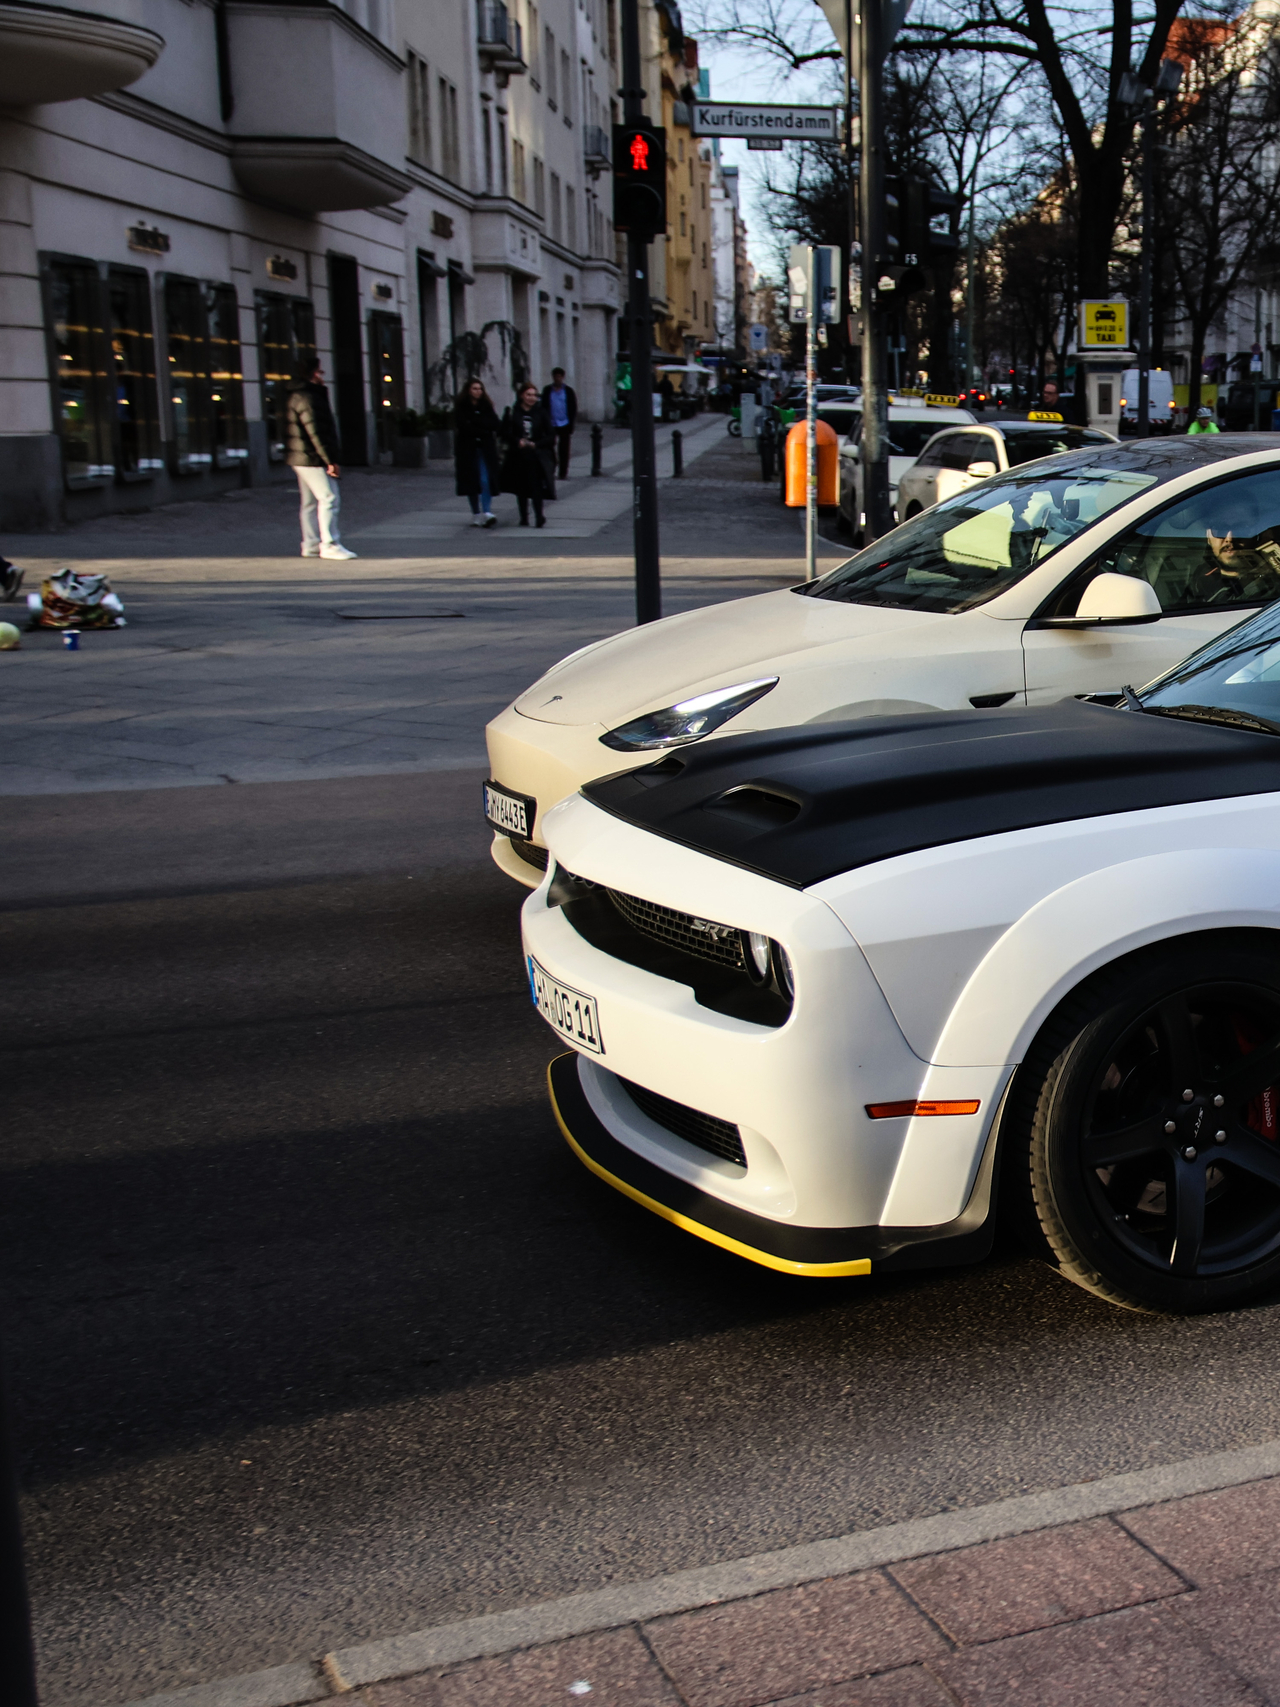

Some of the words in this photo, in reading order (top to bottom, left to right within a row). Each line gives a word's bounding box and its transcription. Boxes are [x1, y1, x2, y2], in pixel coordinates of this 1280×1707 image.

[699, 109, 831, 129] Kurfürstendamm
[690, 918, 736, 942] SRT
[1263, 1091, 1274, 1128] brembo
